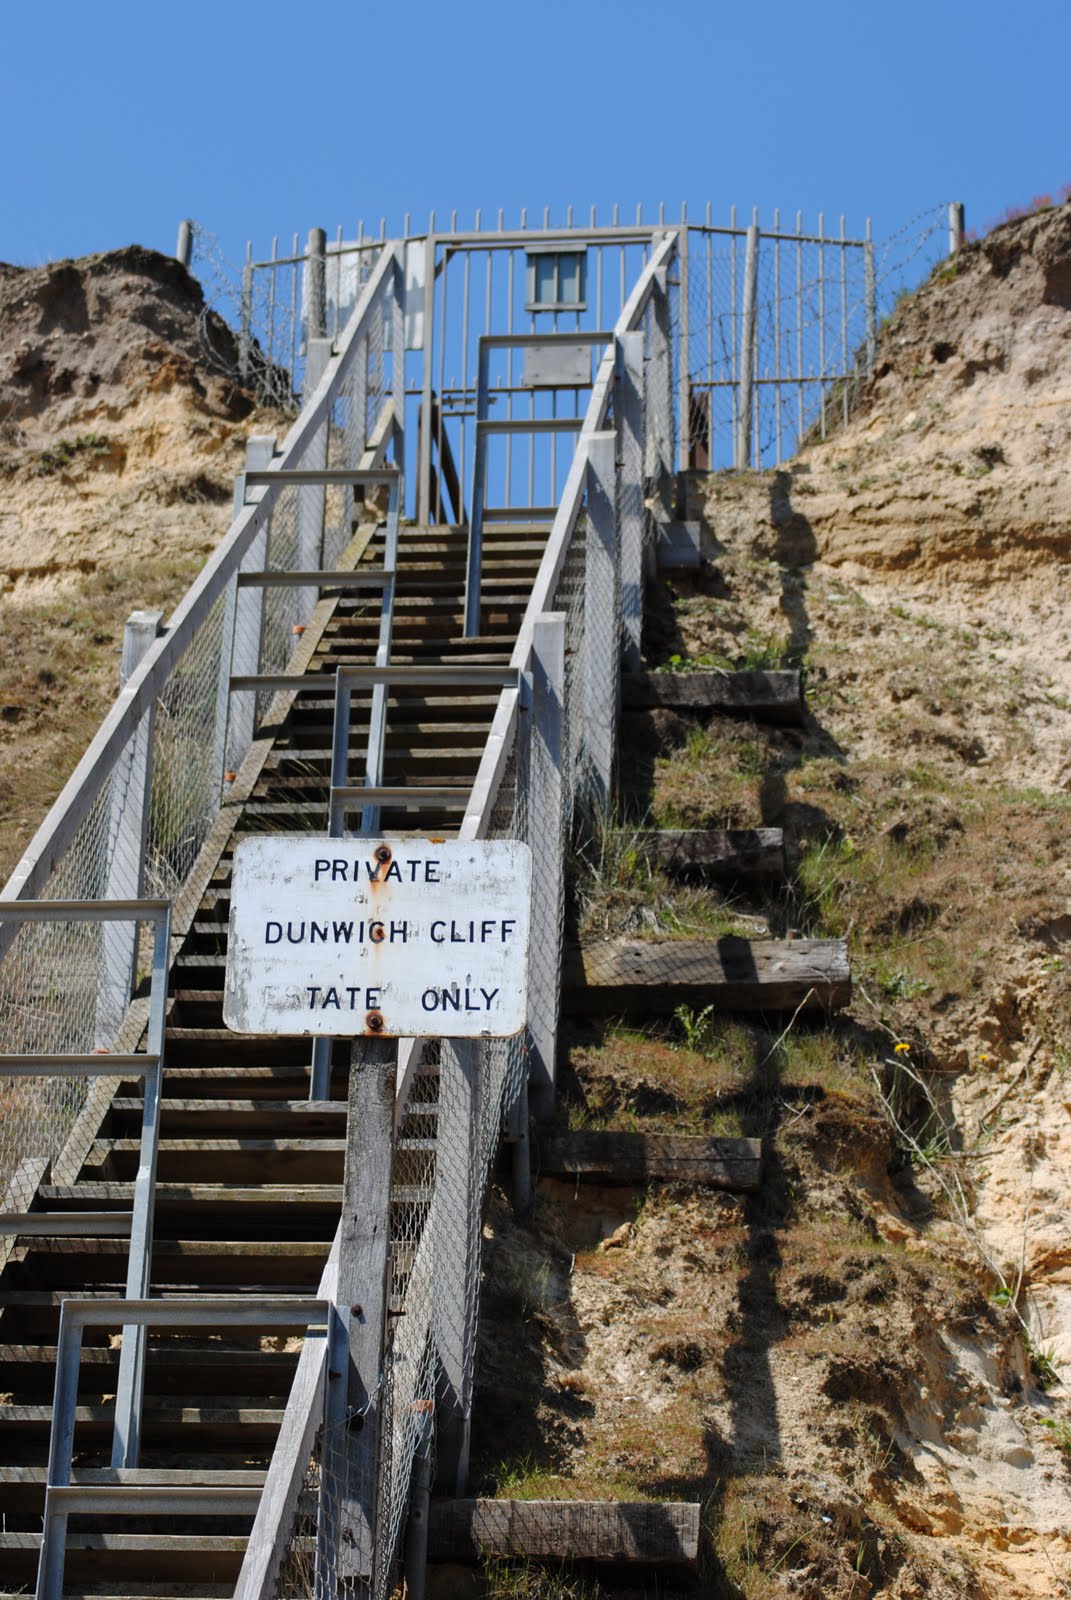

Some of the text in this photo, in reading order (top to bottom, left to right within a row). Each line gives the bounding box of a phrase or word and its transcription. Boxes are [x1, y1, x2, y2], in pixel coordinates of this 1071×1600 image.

[314, 859, 441, 883] PRIVATE
[265, 919, 517, 944] DUNWICH CLIFF
[421, 987, 500, 1012] ONLY
